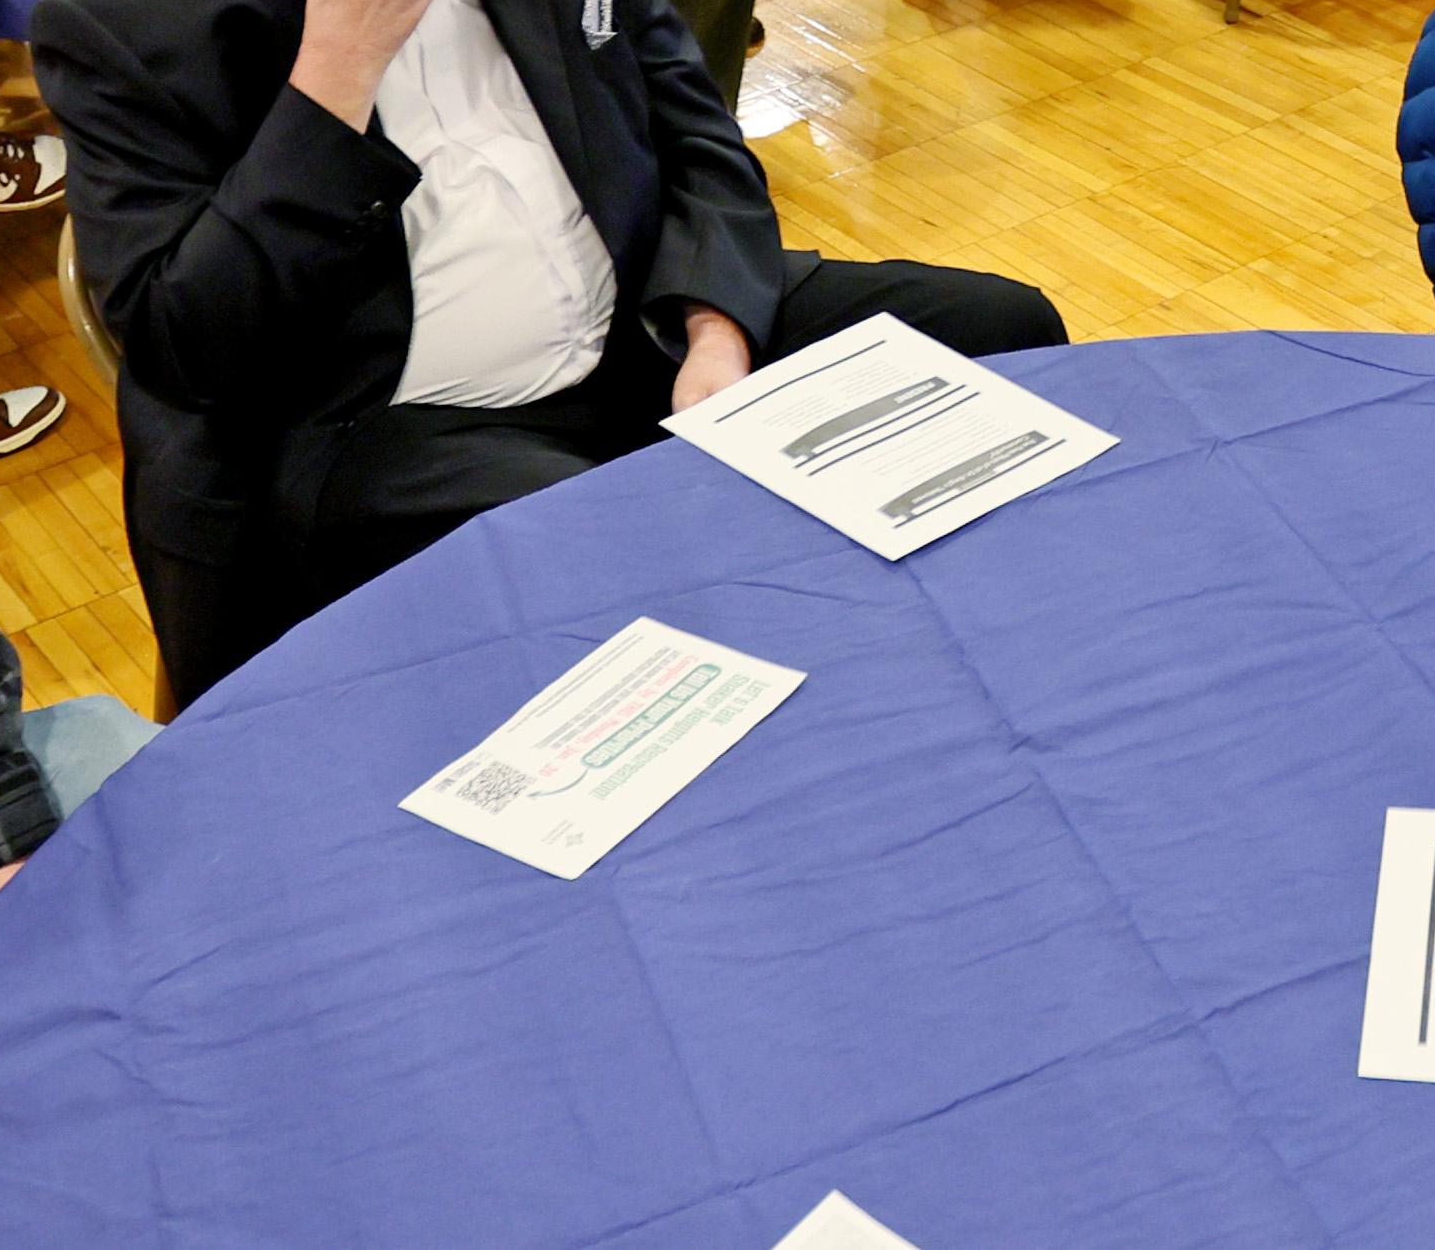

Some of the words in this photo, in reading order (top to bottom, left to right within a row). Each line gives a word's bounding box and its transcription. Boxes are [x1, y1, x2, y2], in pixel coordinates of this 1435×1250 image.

[698, 673, 751, 710] Shaker
[654, 706, 711, 746] Heights
[707, 703, 744, 727] Talk
